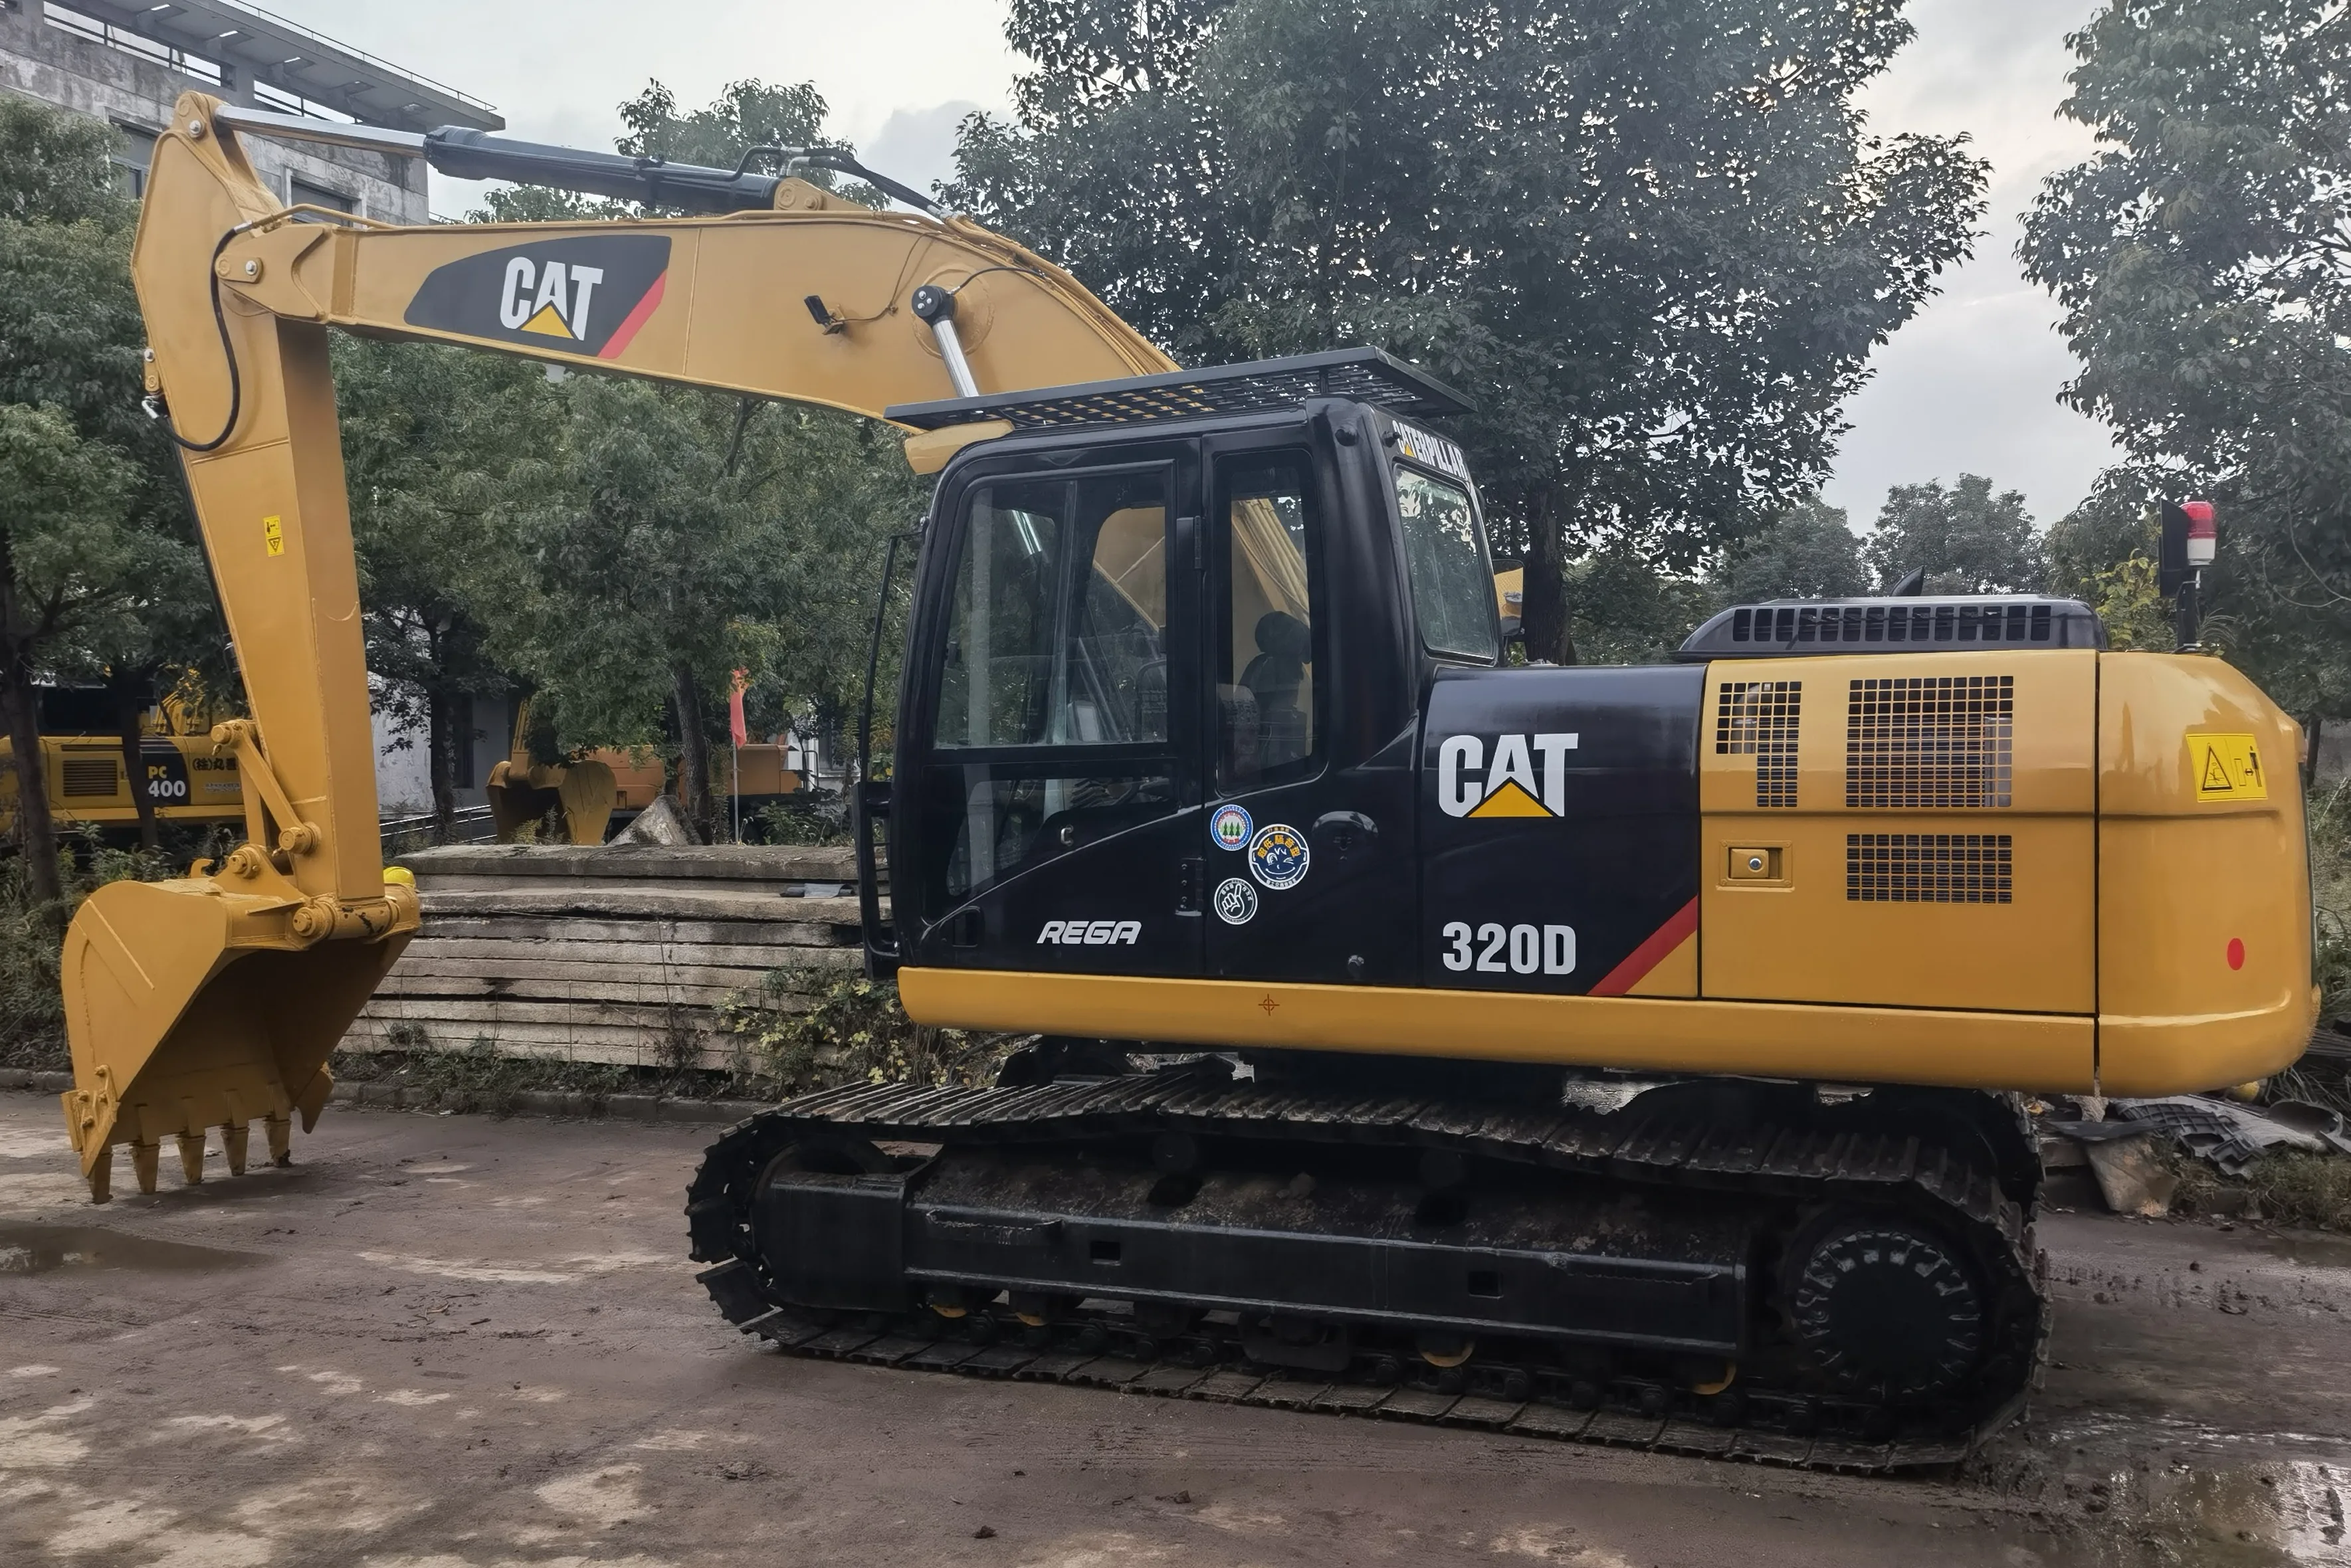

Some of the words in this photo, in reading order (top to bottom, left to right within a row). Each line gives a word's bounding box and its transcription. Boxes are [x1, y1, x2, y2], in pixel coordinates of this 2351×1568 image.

[500, 256, 603, 341] CAT
[1392, 420, 1469, 480] CATERPILLAR
[148, 766, 167, 779] PC
[148, 781, 186, 797] 400
[1439, 733, 1578, 818] CAT
[1037, 921, 1142, 944] REGA
[1443, 922, 1576, 975] 320D
